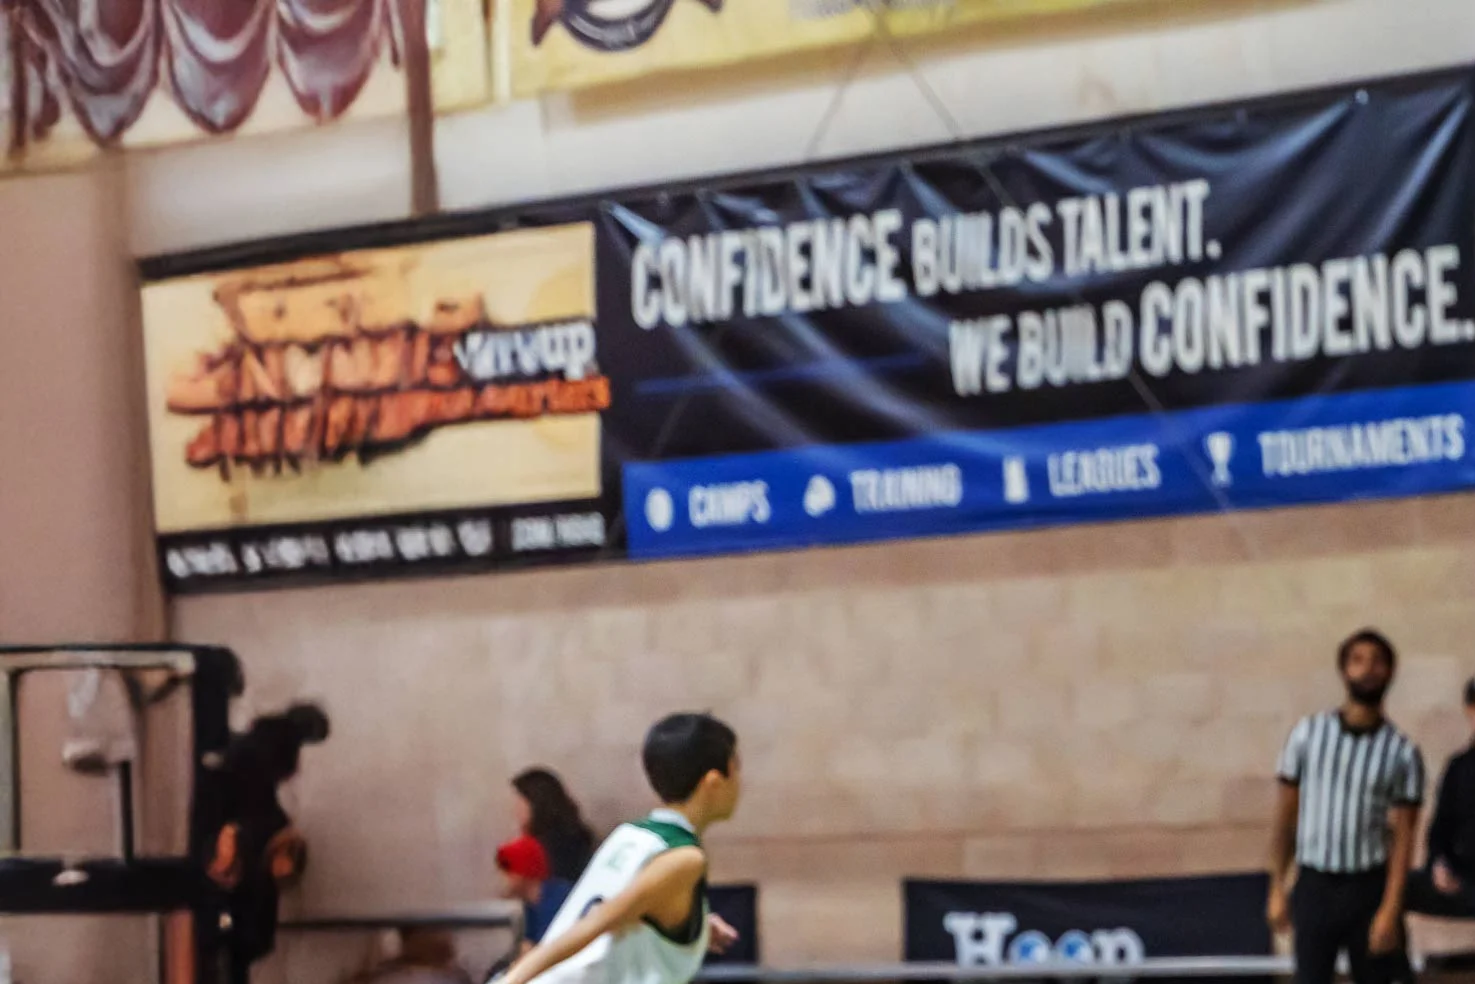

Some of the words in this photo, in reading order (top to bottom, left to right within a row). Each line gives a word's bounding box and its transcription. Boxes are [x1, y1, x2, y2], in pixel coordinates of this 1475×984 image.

[631, 207, 907, 329] CONFIDENCE
[911, 199, 1053, 293] BUILDS
[1056, 179, 1220, 267] TALENT.
[948, 314, 1012, 396] WE
[1016, 299, 1136, 391] BUILD
[688, 478, 771, 528] CAMPS
[849, 461, 963, 514] TRAINING
[1046, 443, 1162, 497] LEAGUES
[1257, 413, 1466, 477] TOURNAMENTS
